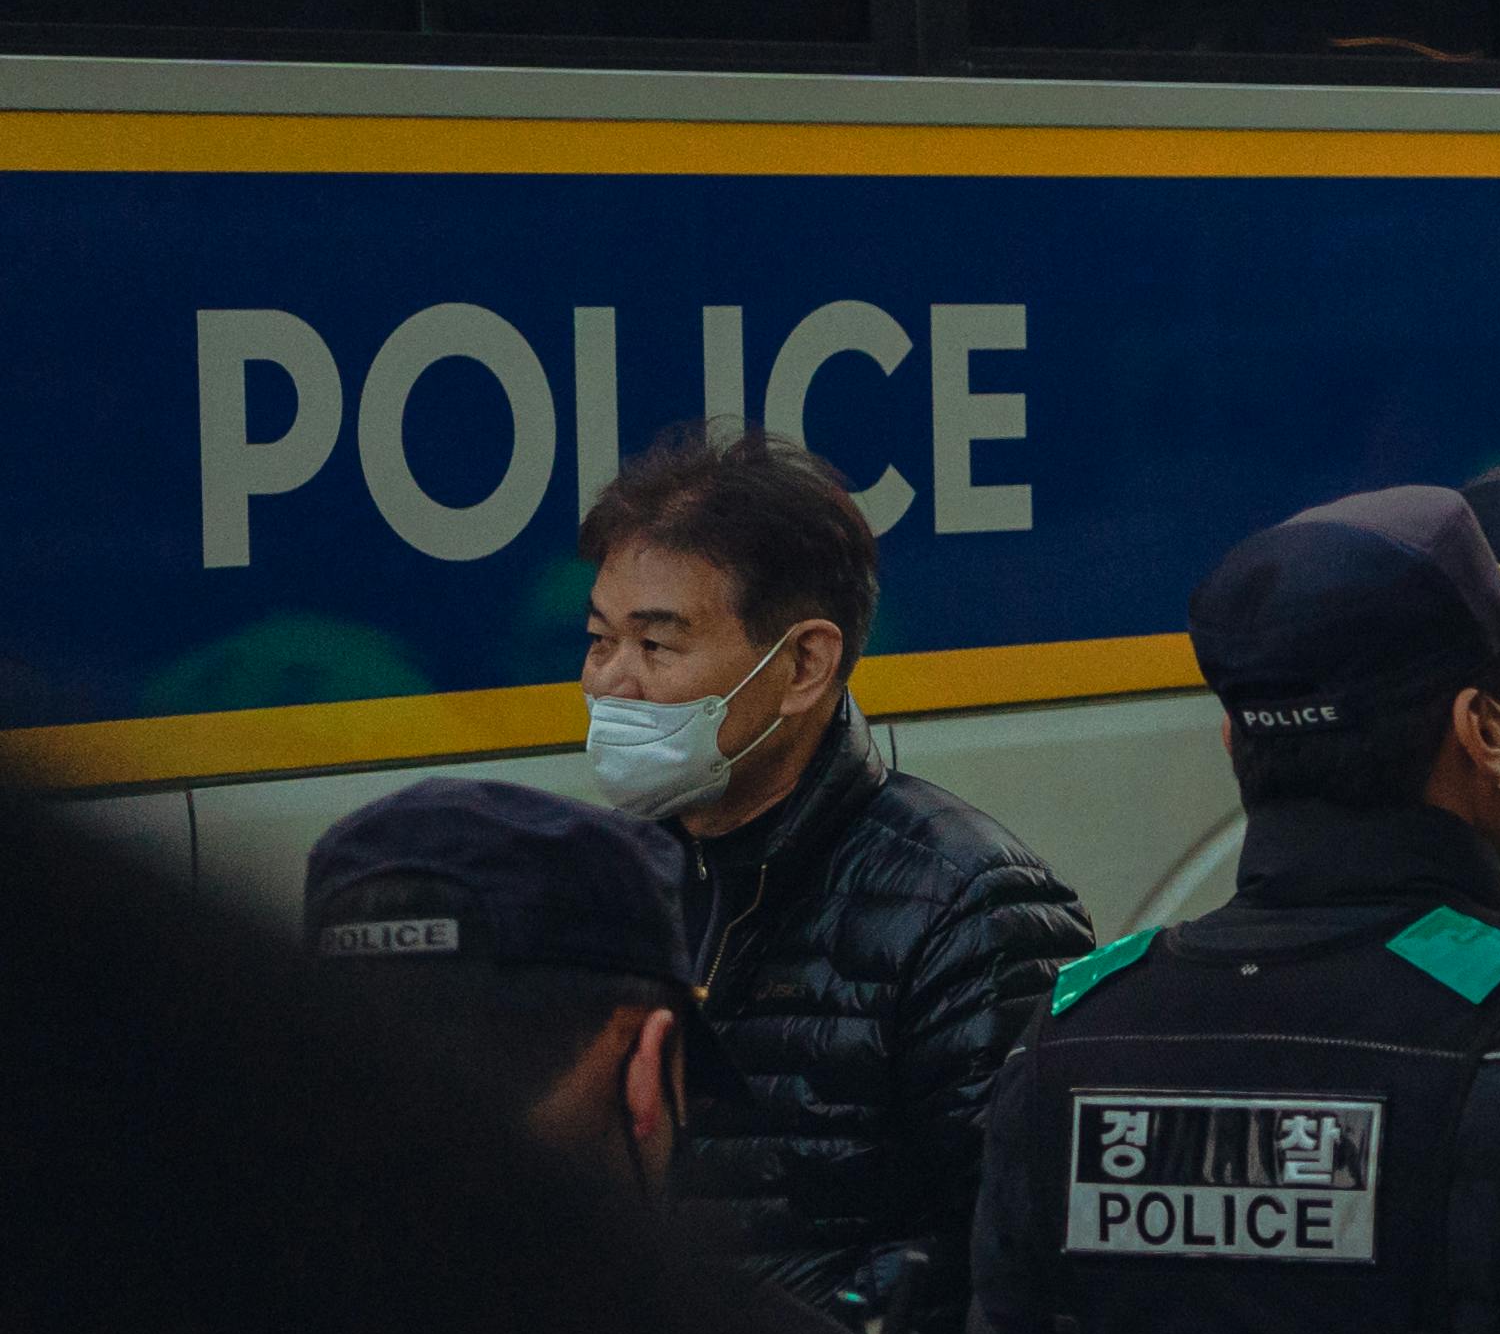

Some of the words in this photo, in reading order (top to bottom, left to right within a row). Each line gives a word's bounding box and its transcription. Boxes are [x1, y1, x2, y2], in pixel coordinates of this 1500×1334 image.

[196, 300, 1034, 570] POLICE
[1242, 705, 1339, 728] POLICE
[1098, 1191, 1334, 1250] POLICE
